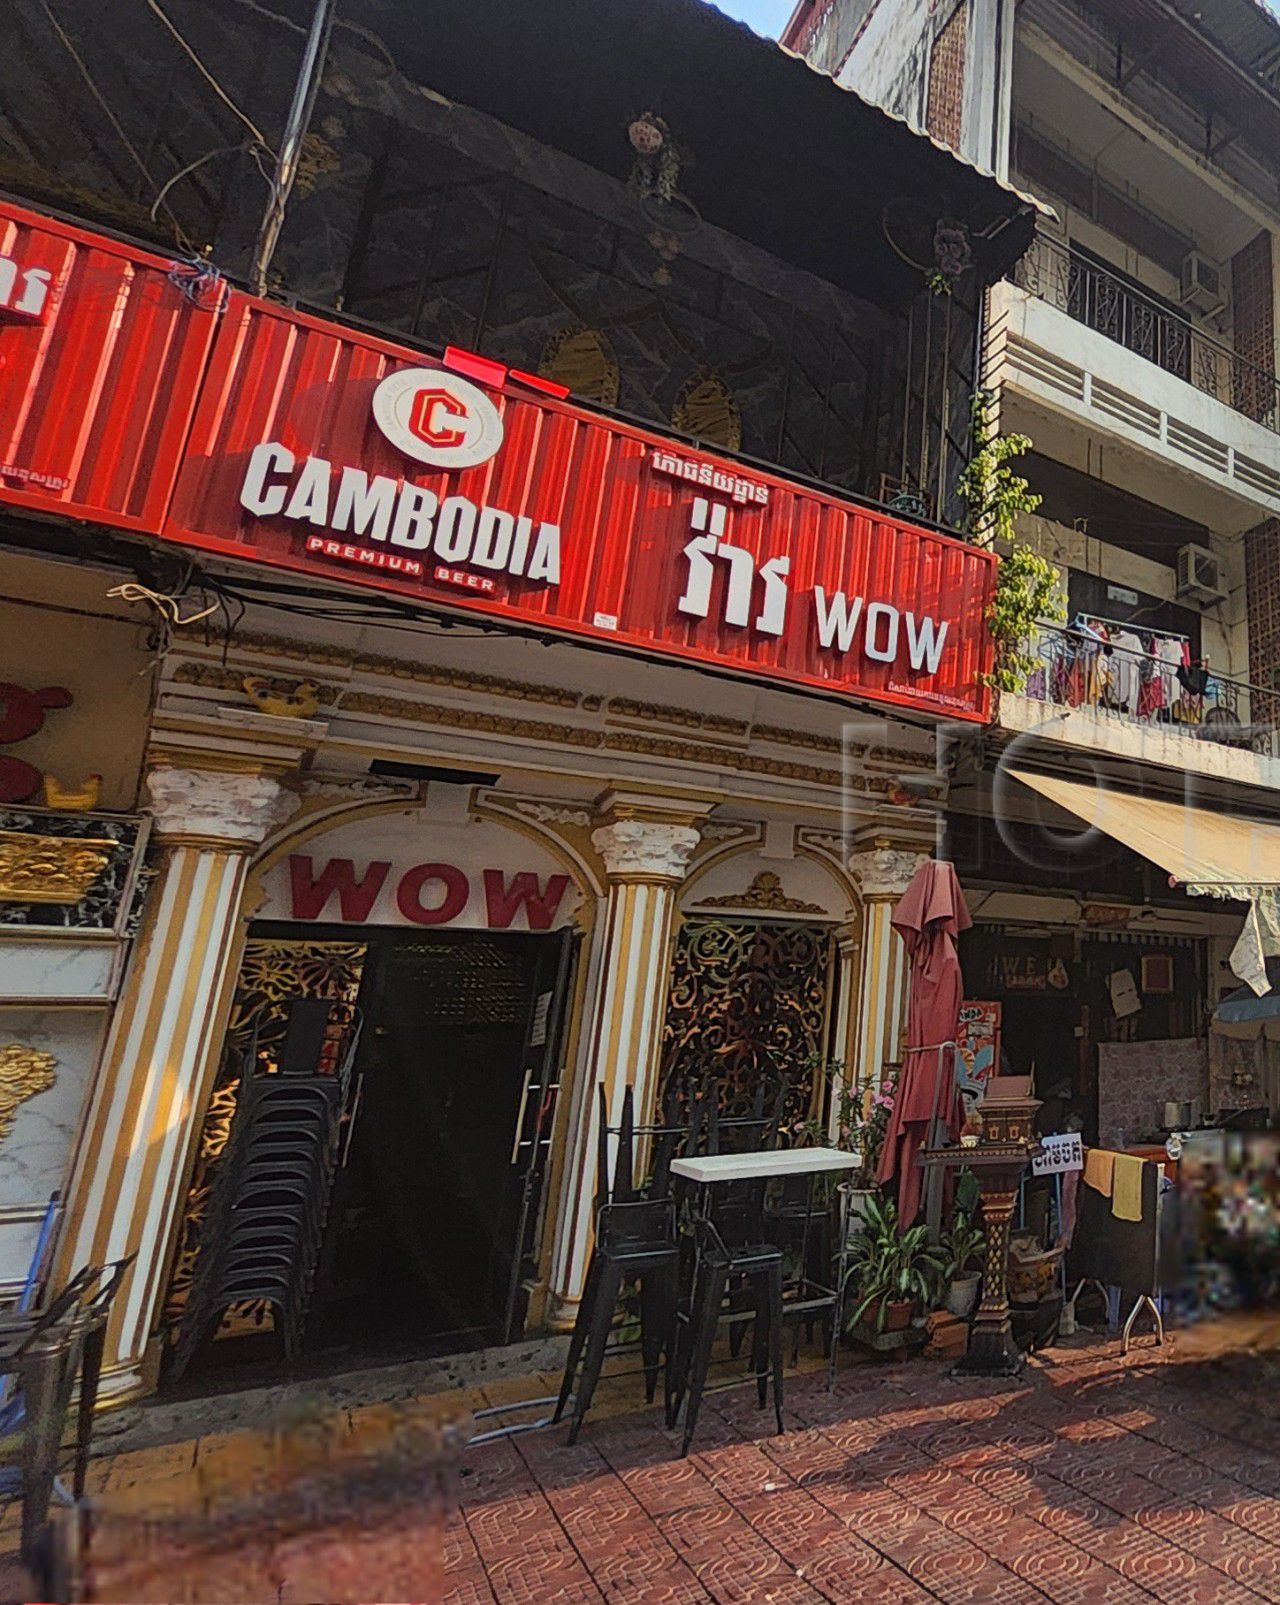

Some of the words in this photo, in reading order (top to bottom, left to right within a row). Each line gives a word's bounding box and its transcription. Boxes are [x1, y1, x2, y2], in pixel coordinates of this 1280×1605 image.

[240, 442, 562, 584] CAMBODIA
[309, 537, 420, 573] PREMIUM
[438, 567, 494, 591] BEER
[814, 585, 949, 675] WOW
[289, 854, 571, 929] WOW
